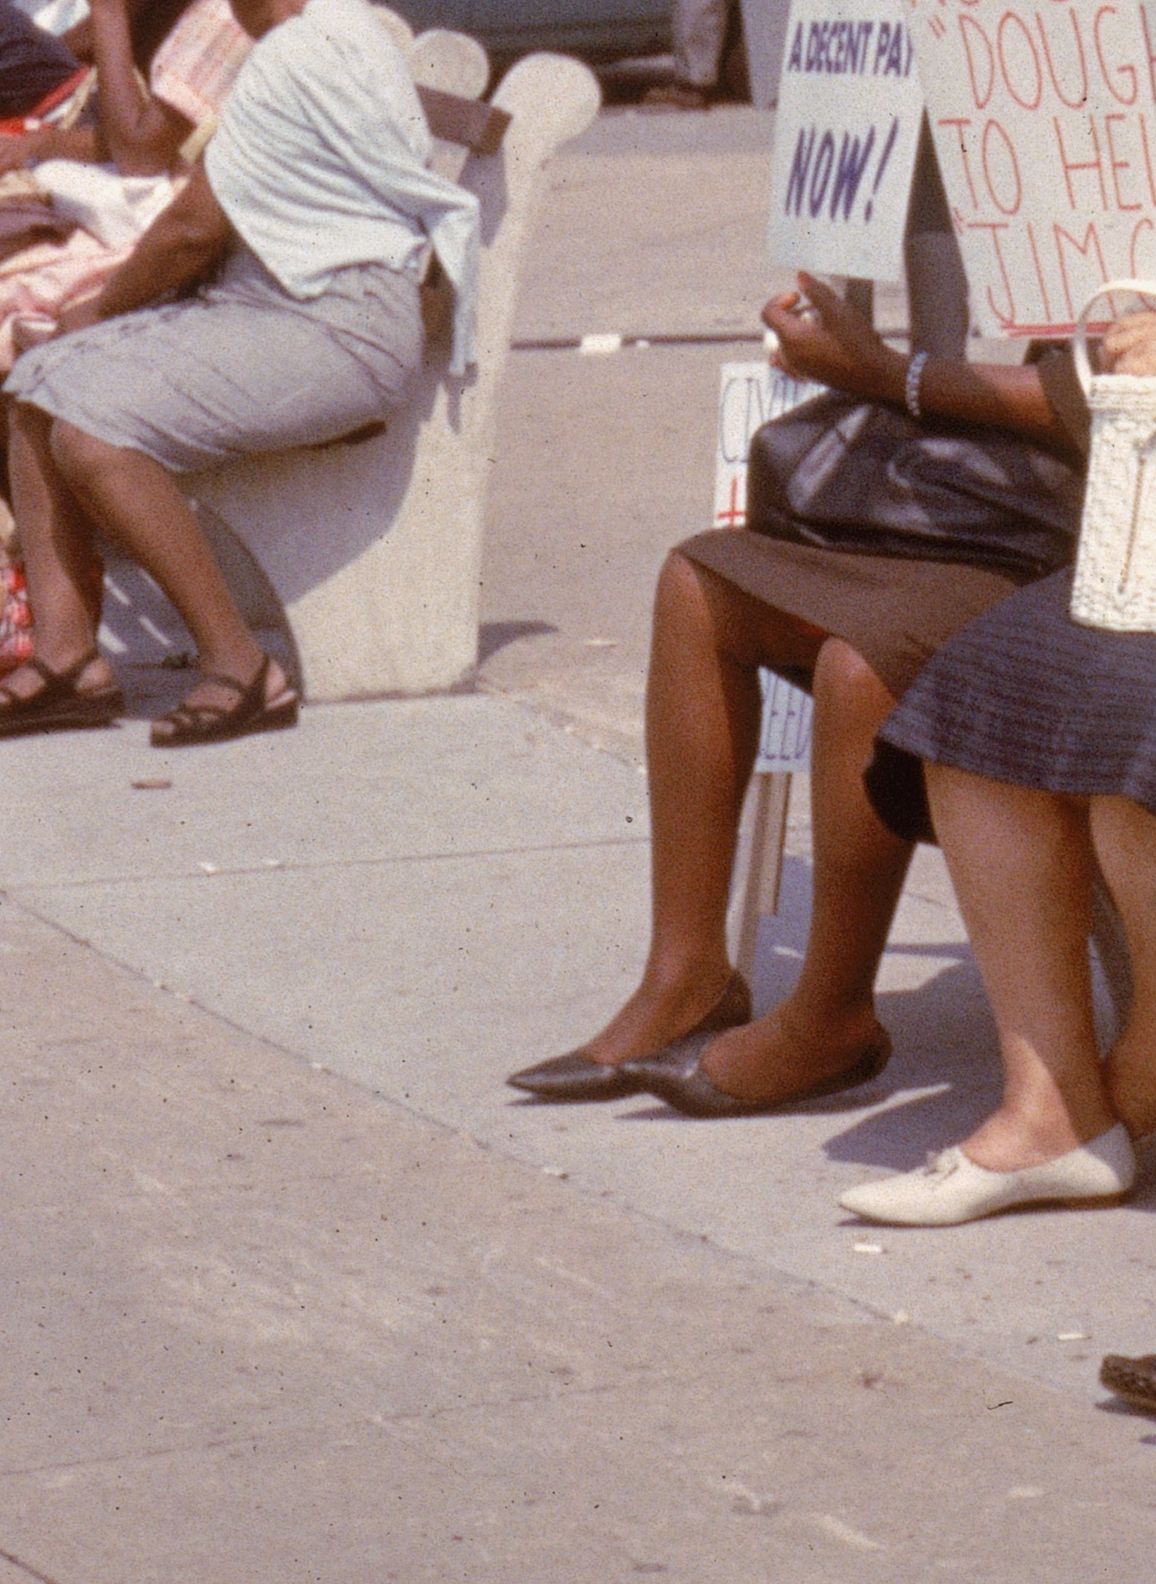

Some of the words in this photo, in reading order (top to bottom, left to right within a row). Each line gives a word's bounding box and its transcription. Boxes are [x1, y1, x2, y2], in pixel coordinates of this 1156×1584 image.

[788, 21, 803, 73] A
[806, 21, 873, 74] DECENT
[785, 117, 900, 222] NOW!
[938, 117, 1021, 215] TO
